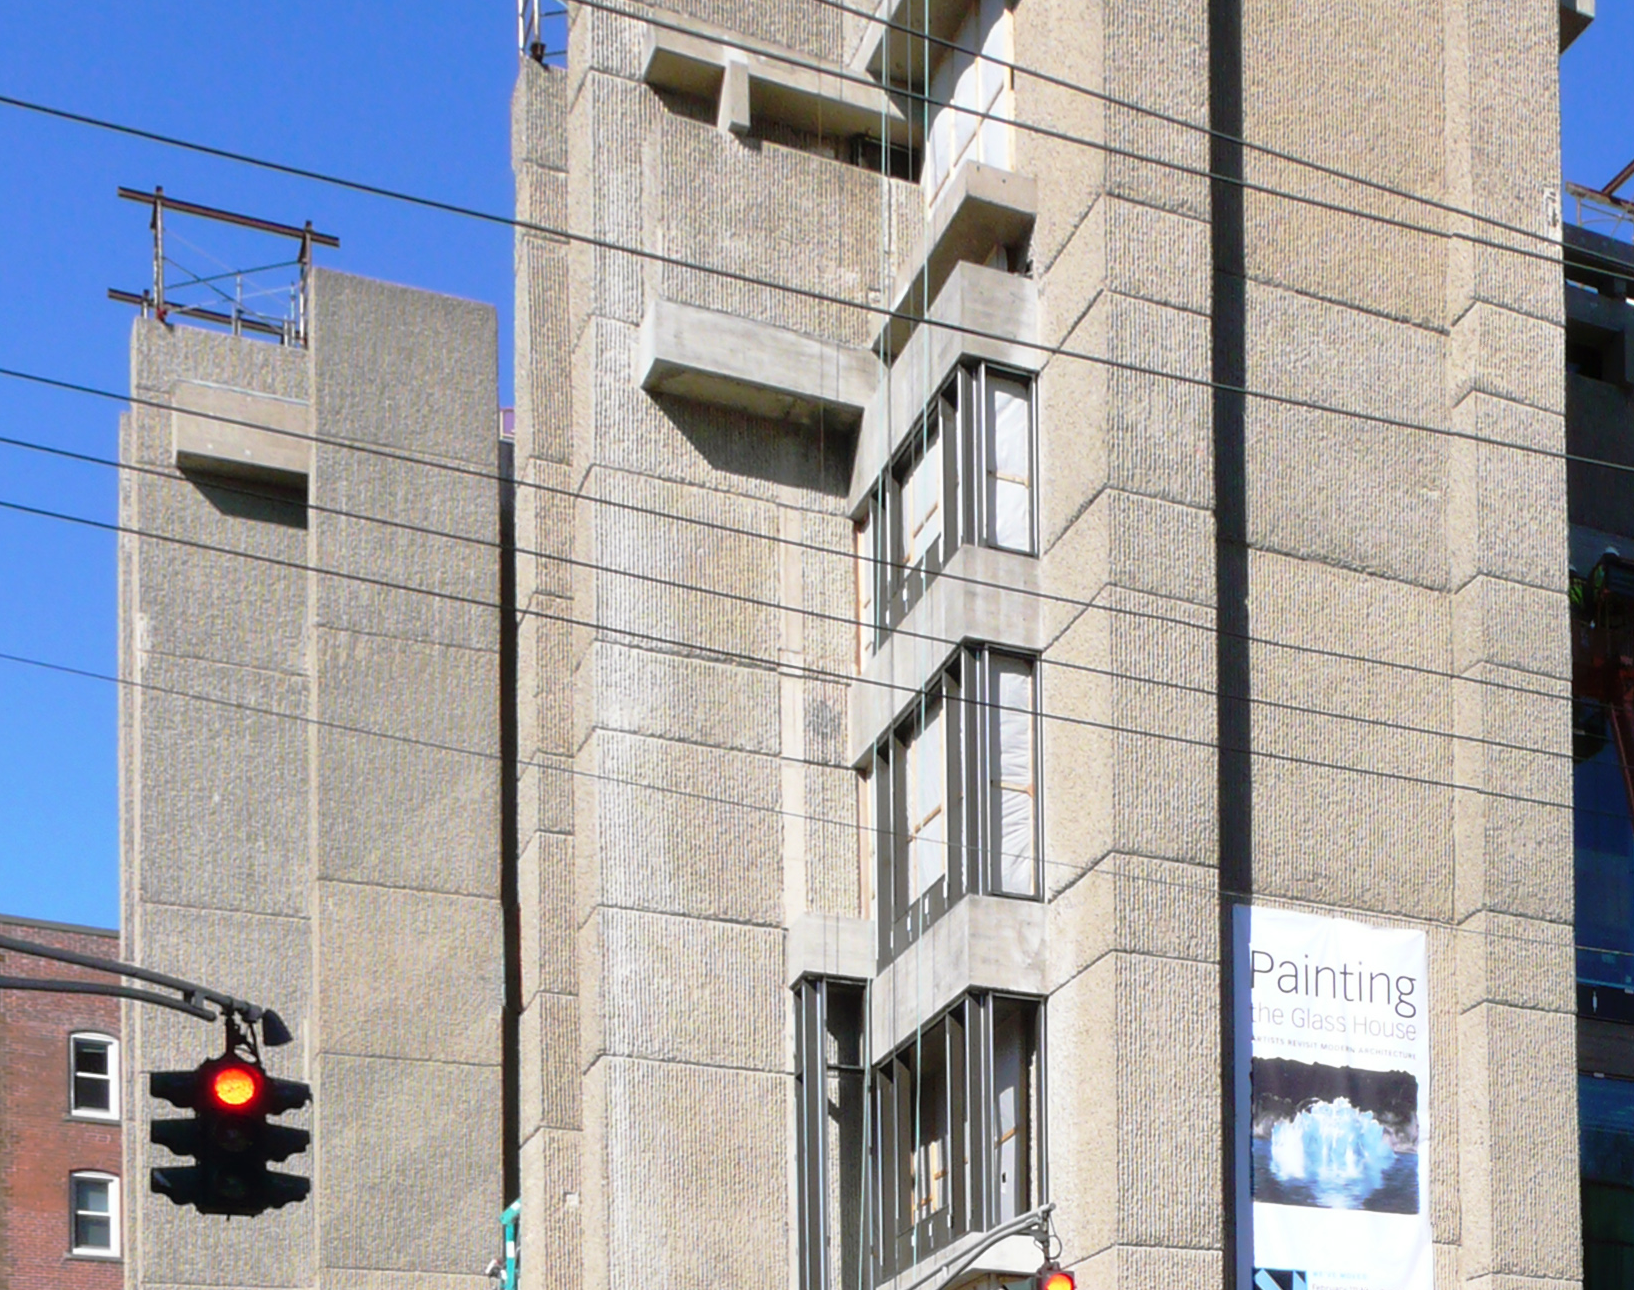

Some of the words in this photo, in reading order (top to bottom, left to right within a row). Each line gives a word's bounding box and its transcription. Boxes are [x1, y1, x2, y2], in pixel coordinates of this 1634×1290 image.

[1251, 950, 1417, 1019] Painting
[1251, 1002, 1284, 1025] the
[1291, 1007, 1347, 1033] Glass
[1353, 1015, 1417, 1041] House
[1287, 1039, 1318, 1049] REVISIT
[1320, 1043, 1356, 1054] MODERN
[1358, 1047, 1417, 1060] ARCHITECTURE
